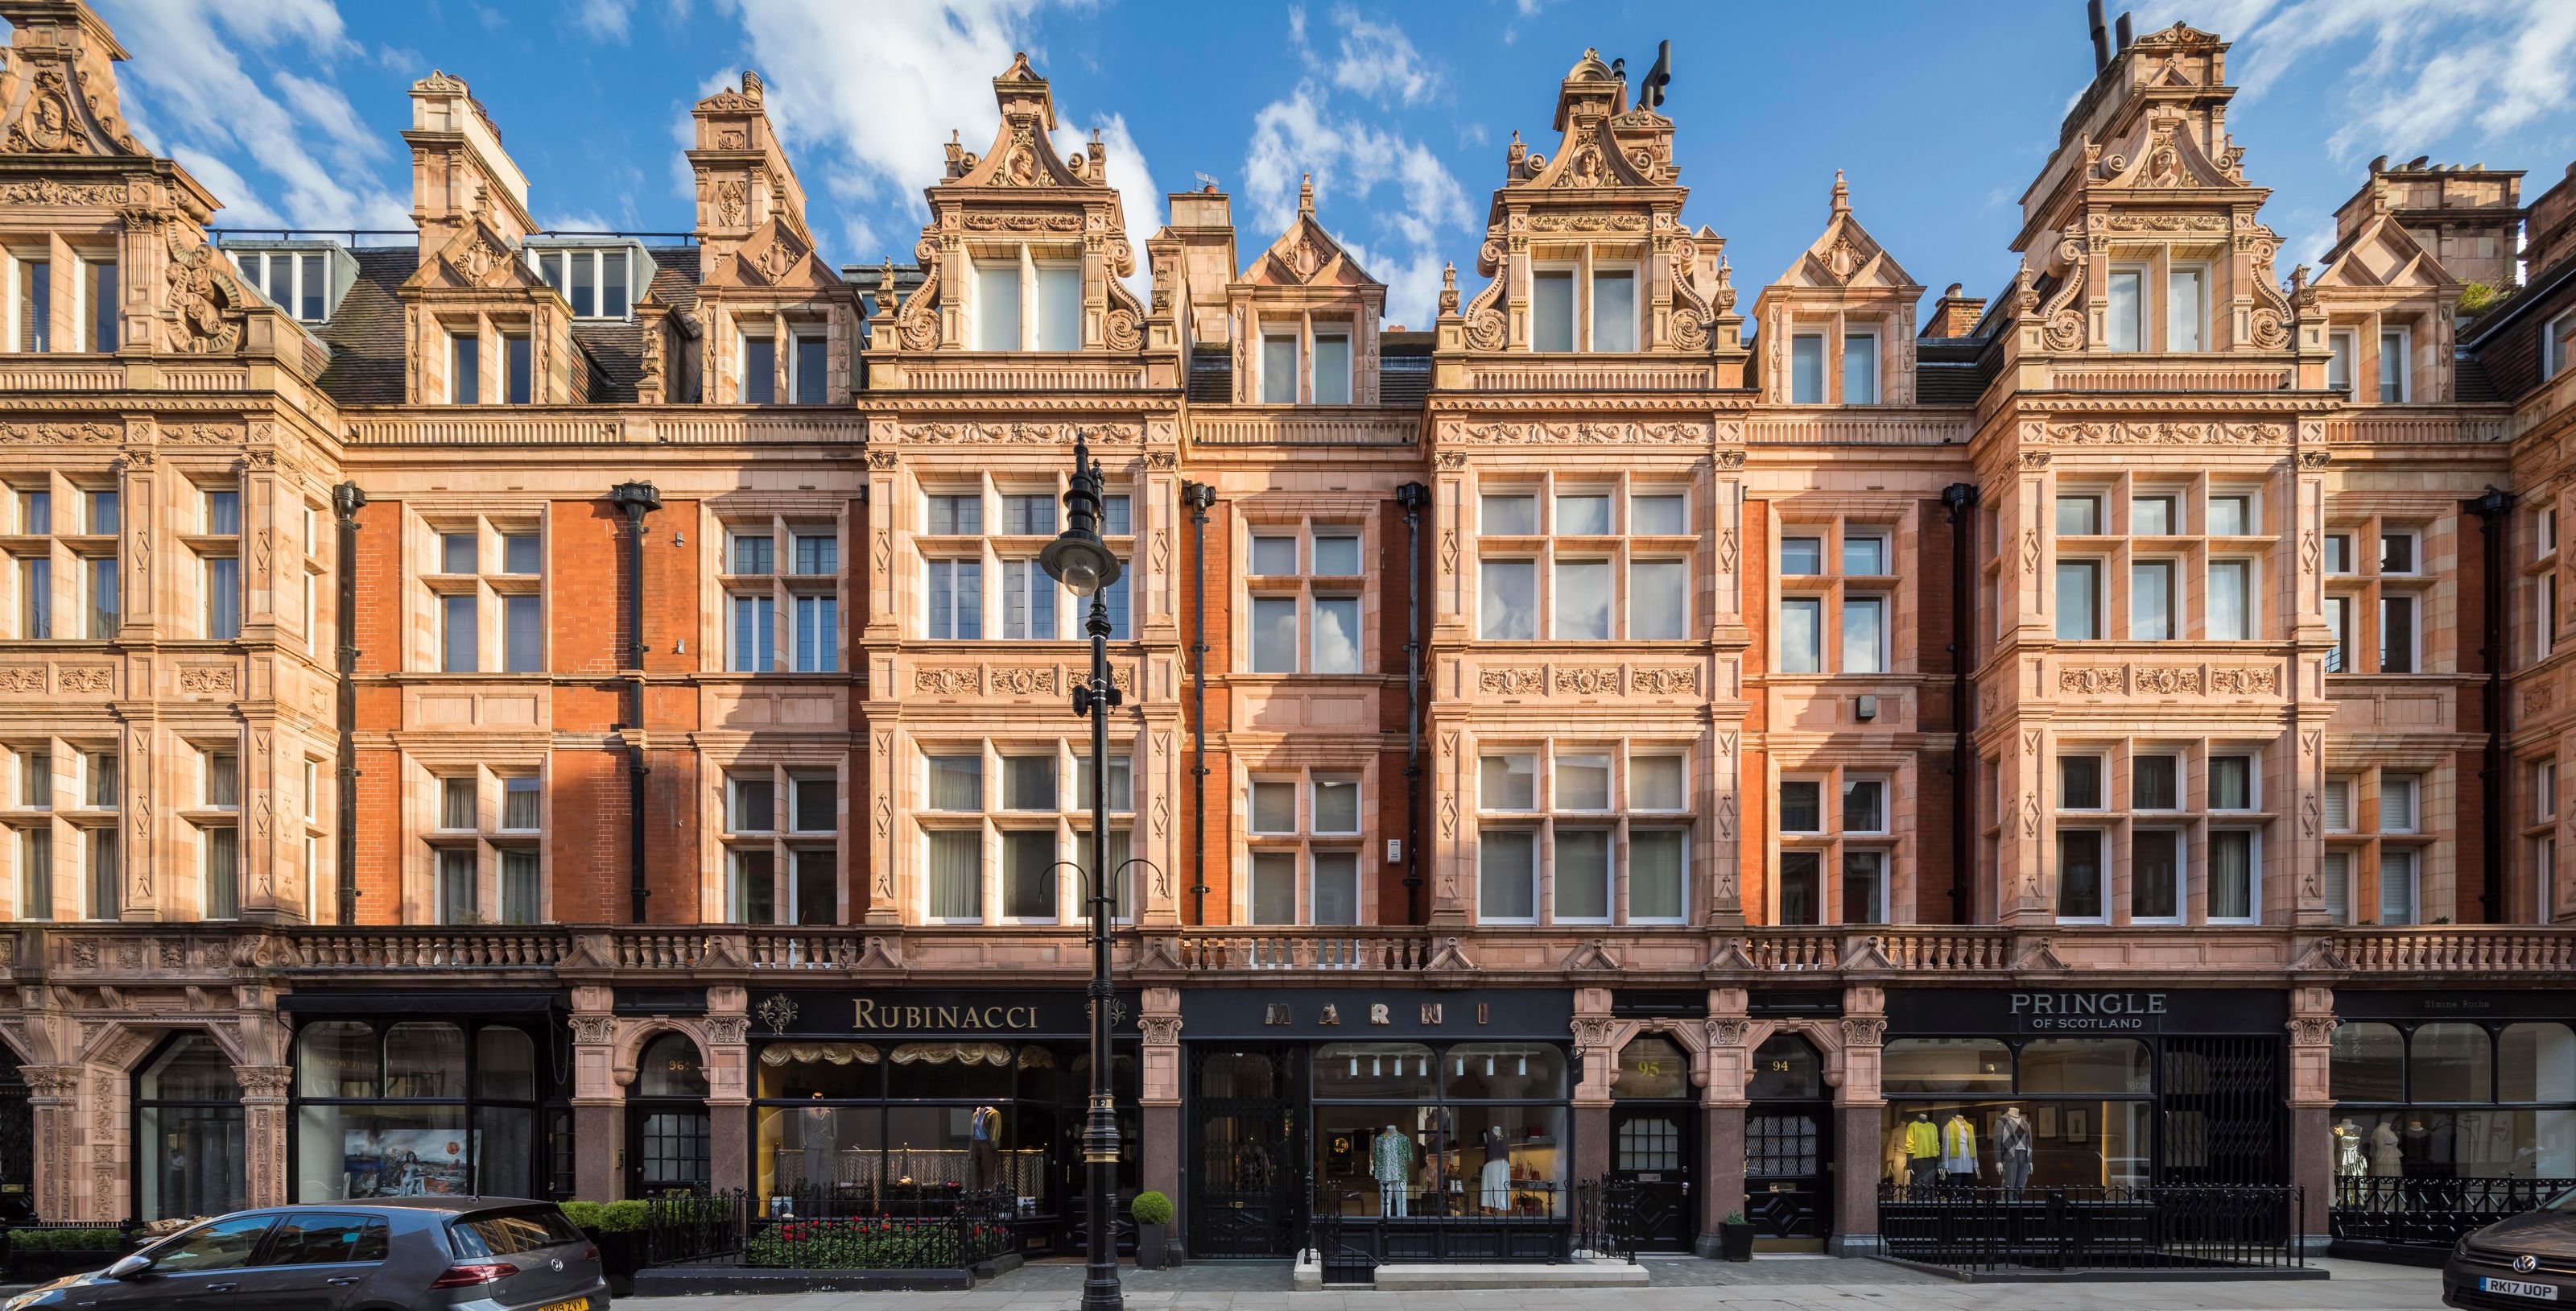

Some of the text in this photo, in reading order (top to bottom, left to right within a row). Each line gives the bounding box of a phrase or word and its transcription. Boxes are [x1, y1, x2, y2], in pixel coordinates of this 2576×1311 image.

[2009, 993, 2167, 1015] PRINGLE
[2424, 999, 2489, 1008] Simone Rocha
[852, 998, 1038, 1028] RUBINACCI
[1264, 1003, 1489, 1025] MARNI
[2033, 1019, 2142, 1028] OF SCOTLAND
[1638, 1060, 1659, 1077] 95
[1773, 1061, 1789, 1071] 94
[2491, 1280, 2552, 1297] RK17 UOP
[565, 1299, 582, 1311] ZVY
